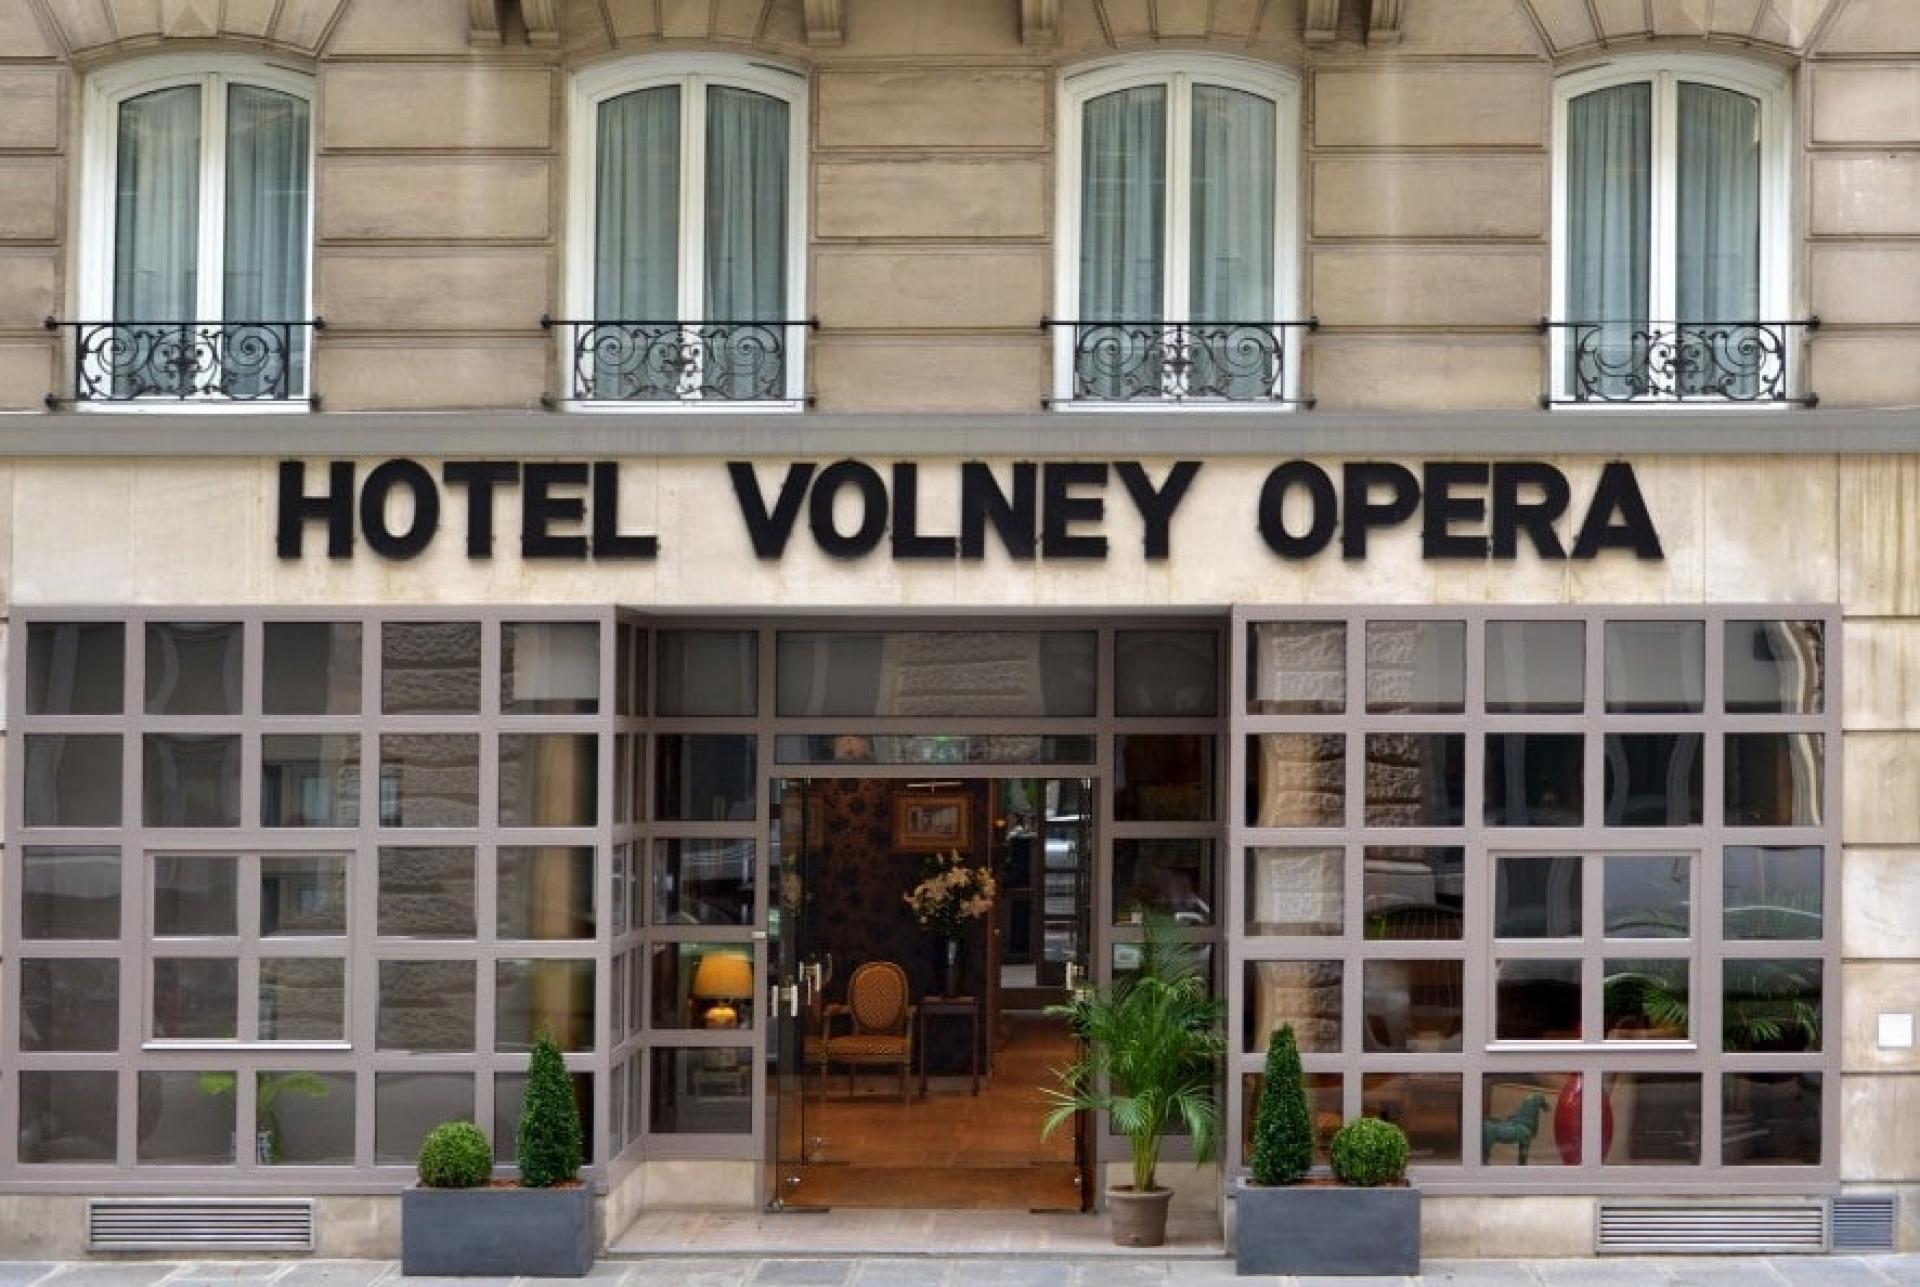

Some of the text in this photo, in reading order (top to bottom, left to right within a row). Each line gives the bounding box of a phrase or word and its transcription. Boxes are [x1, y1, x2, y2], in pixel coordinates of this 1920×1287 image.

[278, 458, 1662, 560] HOTEL VOLNEY OPERA
